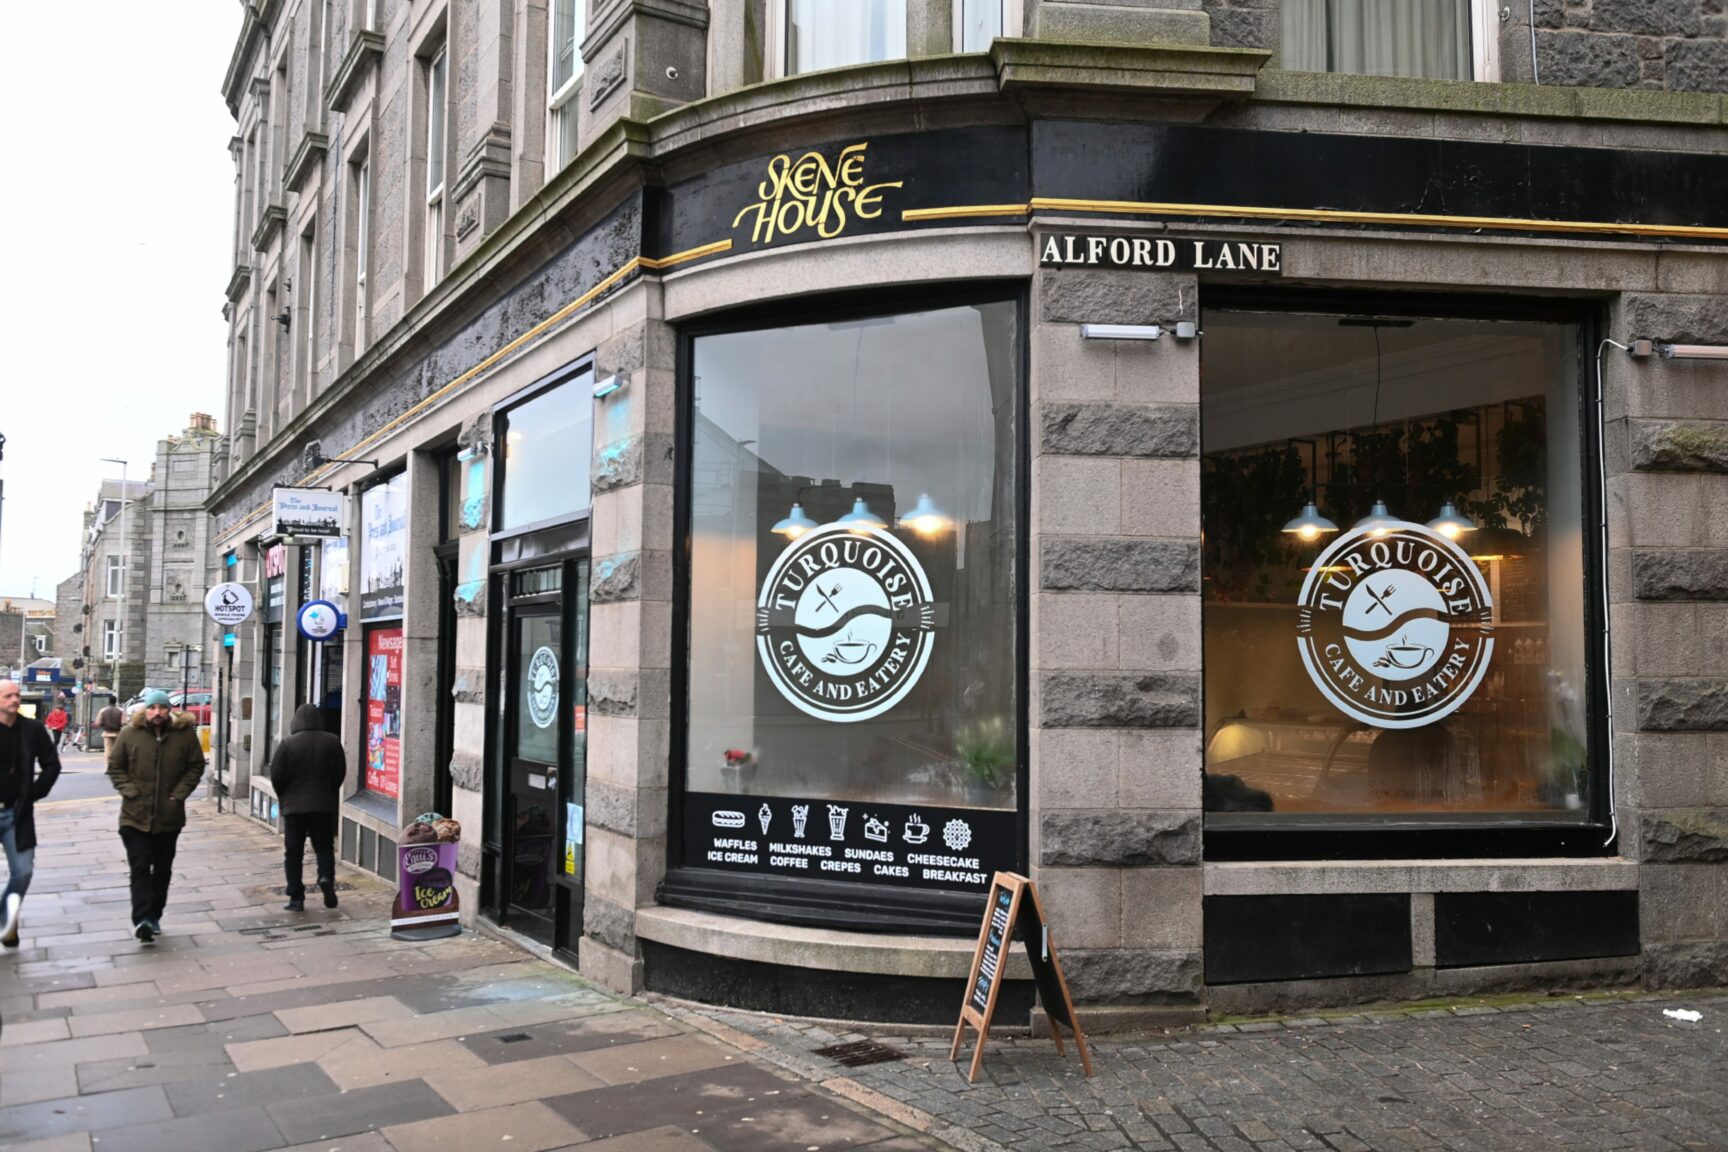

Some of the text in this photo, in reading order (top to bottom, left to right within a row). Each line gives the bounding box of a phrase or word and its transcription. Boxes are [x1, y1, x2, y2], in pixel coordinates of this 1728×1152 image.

[759, 142, 868, 201] SKENE
[732, 181, 904, 244] HOUSE
[1040, 235, 1281, 271] ALFORD LANE
[775, 540, 914, 612] TURQUOISE
[1319, 541, 1473, 616] TURQUOISE
[780, 632, 912, 700] CAFE AND EATERY
[1325, 638, 1471, 706] CAFE AND EATERY
[708, 851, 987, 884] ICE CREAM COFFEE CREPES CAKES BREAKFAST
[713, 838, 980, 869] WAFFLES MILKSHAKES SUNDAES CHEESECAKE
[414, 885, 436, 901] Ice
